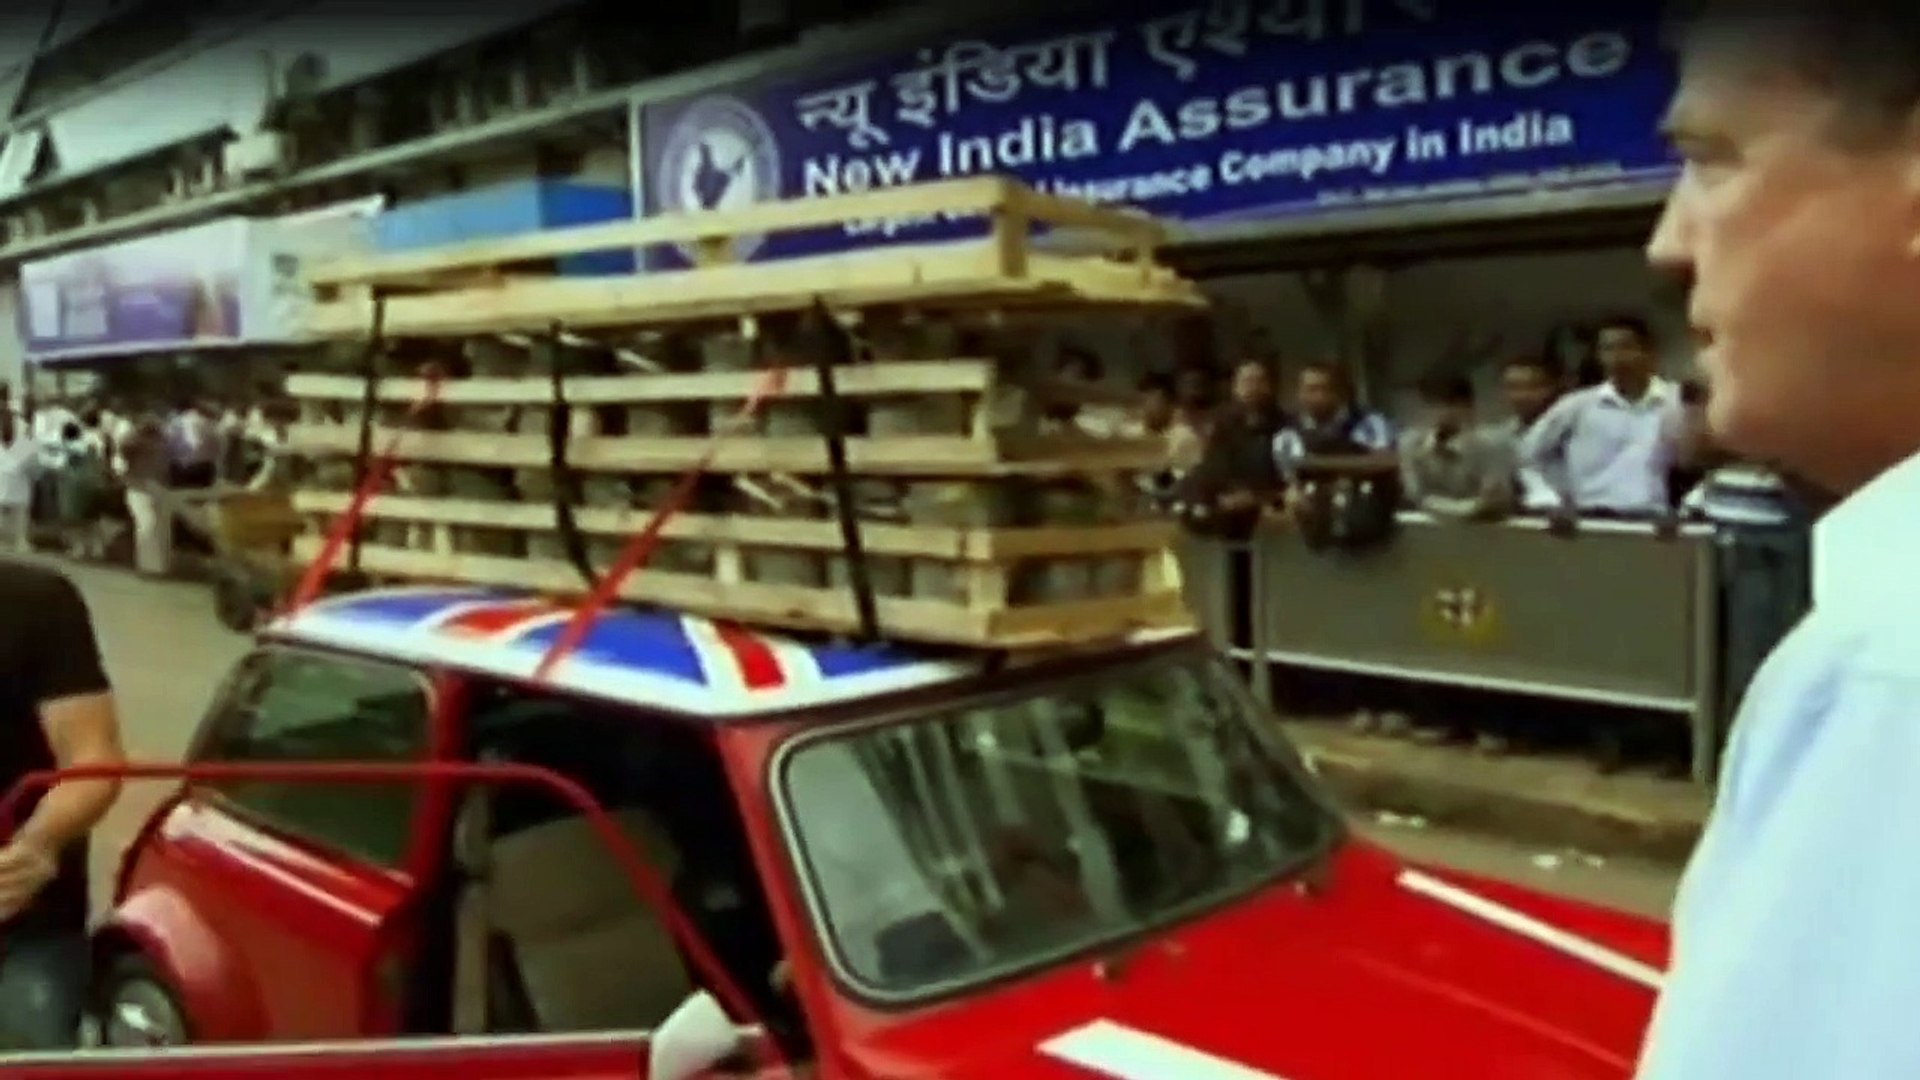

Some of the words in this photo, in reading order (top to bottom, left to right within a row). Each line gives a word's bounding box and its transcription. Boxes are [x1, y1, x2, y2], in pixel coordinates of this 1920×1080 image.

[797, 81, 888, 148] न्यू
[895, 34, 1113, 127] इंडिया
[804, 149, 921, 196] New
[938, 114, 1097, 175] India
[1120, 30, 1630, 152] Assurance
[1219, 138, 1396, 184] Company
[1406, 125, 1446, 161] in
[1460, 111, 1573, 155] India
